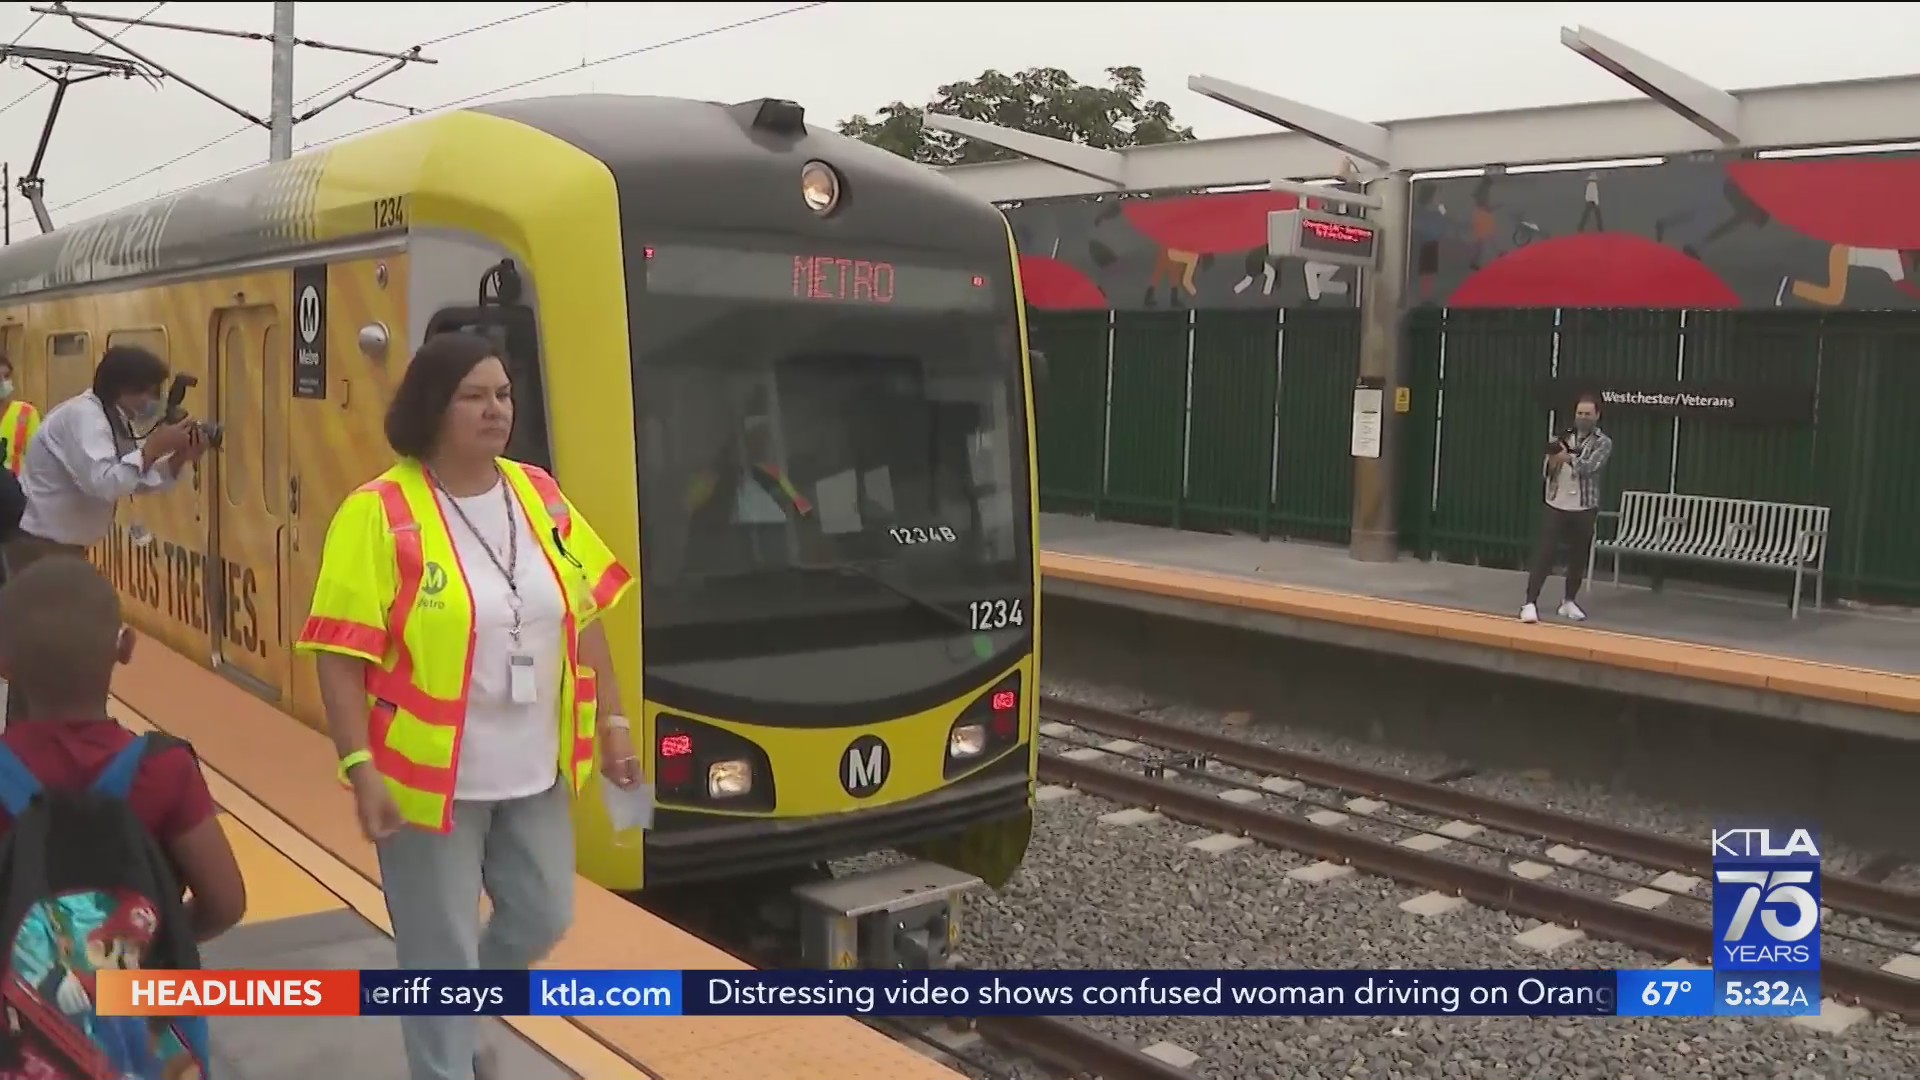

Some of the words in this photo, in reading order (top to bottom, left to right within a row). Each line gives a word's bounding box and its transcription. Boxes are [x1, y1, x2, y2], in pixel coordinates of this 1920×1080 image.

[374, 195, 403, 229] 1234
[793, 255, 895, 302] METRO
[1601, 391, 1735, 408] Westchester/Veterans
[889, 526, 957, 544] 1234B
[969, 599, 1023, 630] 1234
[849, 745, 882, 789] M
